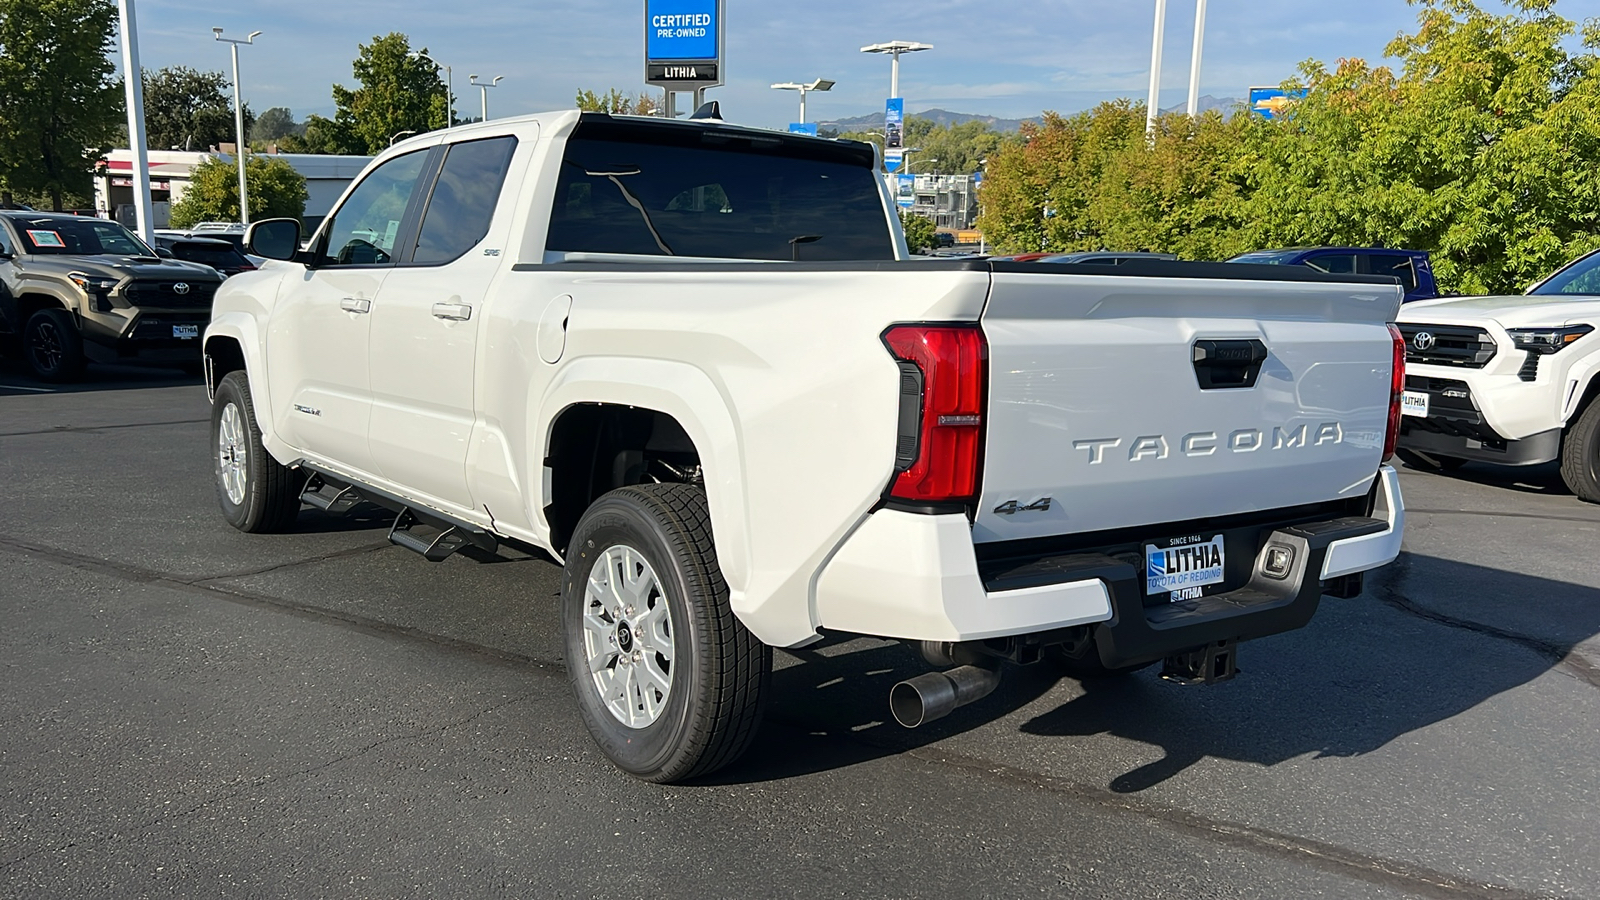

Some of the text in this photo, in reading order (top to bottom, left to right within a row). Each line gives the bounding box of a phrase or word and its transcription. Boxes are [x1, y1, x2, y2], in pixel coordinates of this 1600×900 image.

[652, 13, 711, 28] CERTIFIED
[657, 27, 706, 38] PRE-OWNED
[664, 66, 697, 78] LITHIA
[1404, 396, 1426, 408] LITHIA
[1071, 421, 1343, 465] TACOMA
[1169, 534, 1202, 546] SINCE 1946
[1165, 544, 1222, 574] LITHIA
[1147, 568, 1222, 589] TOYOTA OF REDDING
[1178, 586, 1203, 600] LITHIA
